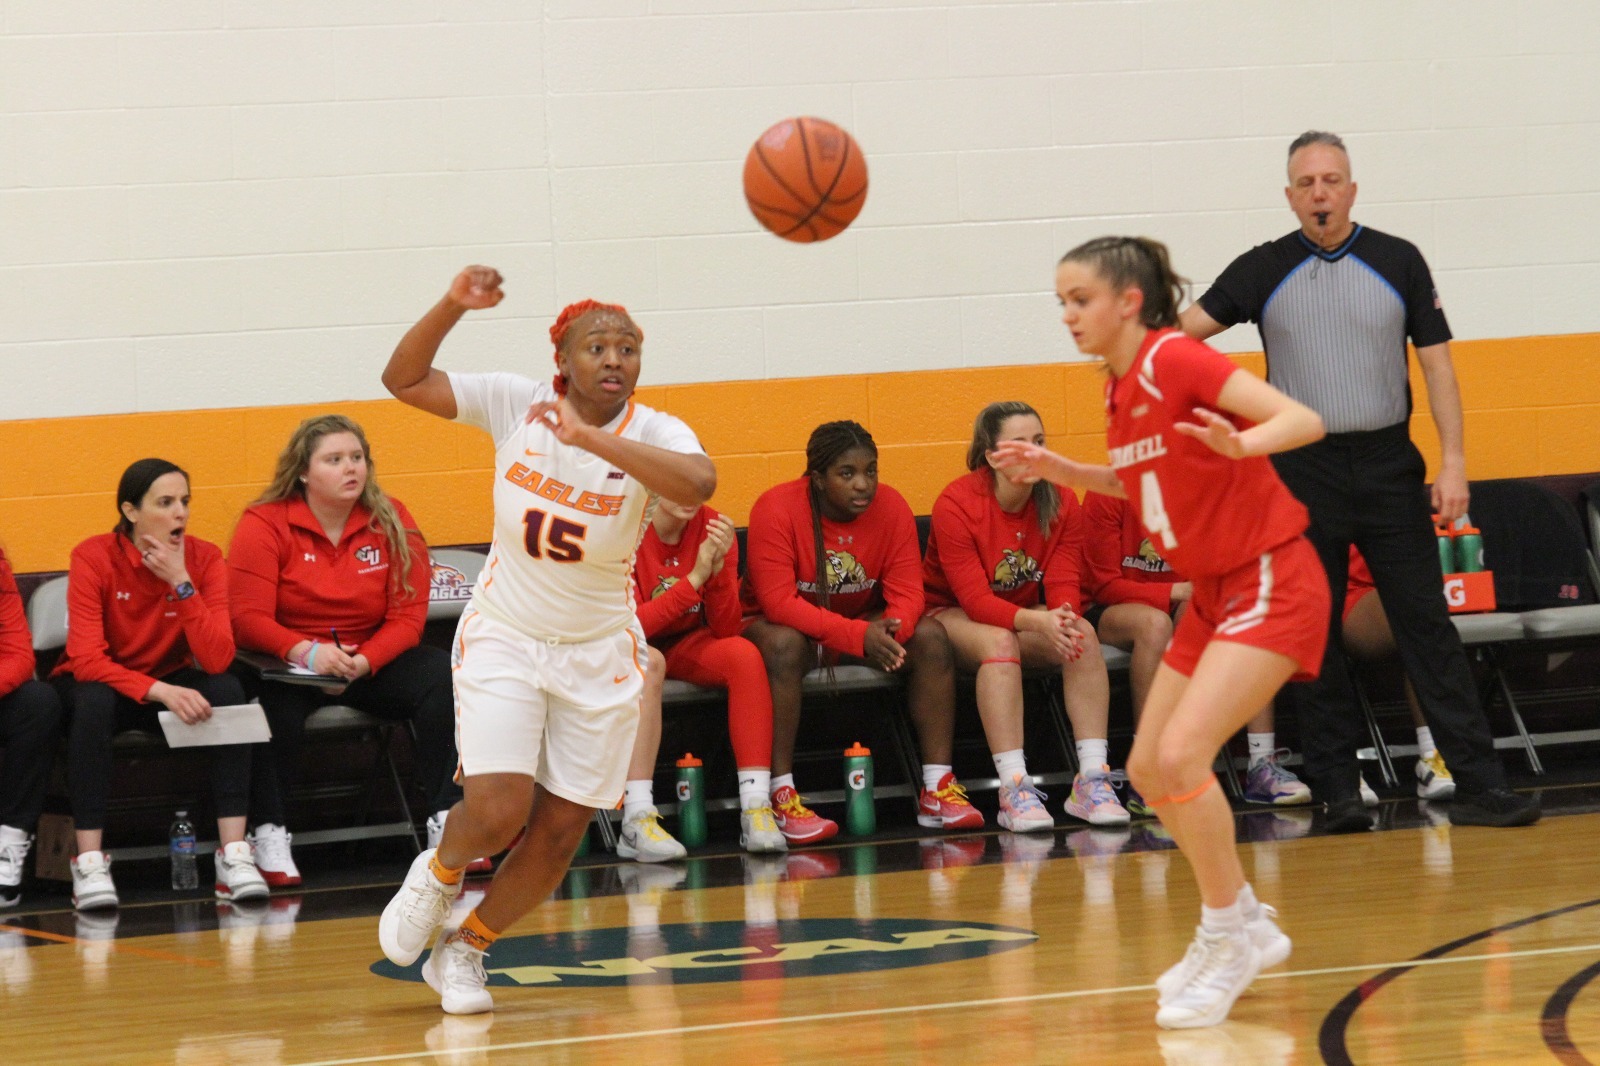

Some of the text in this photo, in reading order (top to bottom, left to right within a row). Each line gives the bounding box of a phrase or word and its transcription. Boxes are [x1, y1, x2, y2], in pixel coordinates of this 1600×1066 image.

[504, 461, 626, 516] EAGLES
[1140, 470, 1179, 549] 4
[522, 507, 588, 564] 15
[1443, 579, 1466, 607] G
[676, 781, 691, 801] G
[848, 769, 866, 790] G
[487, 928, 1040, 984] NCAA
